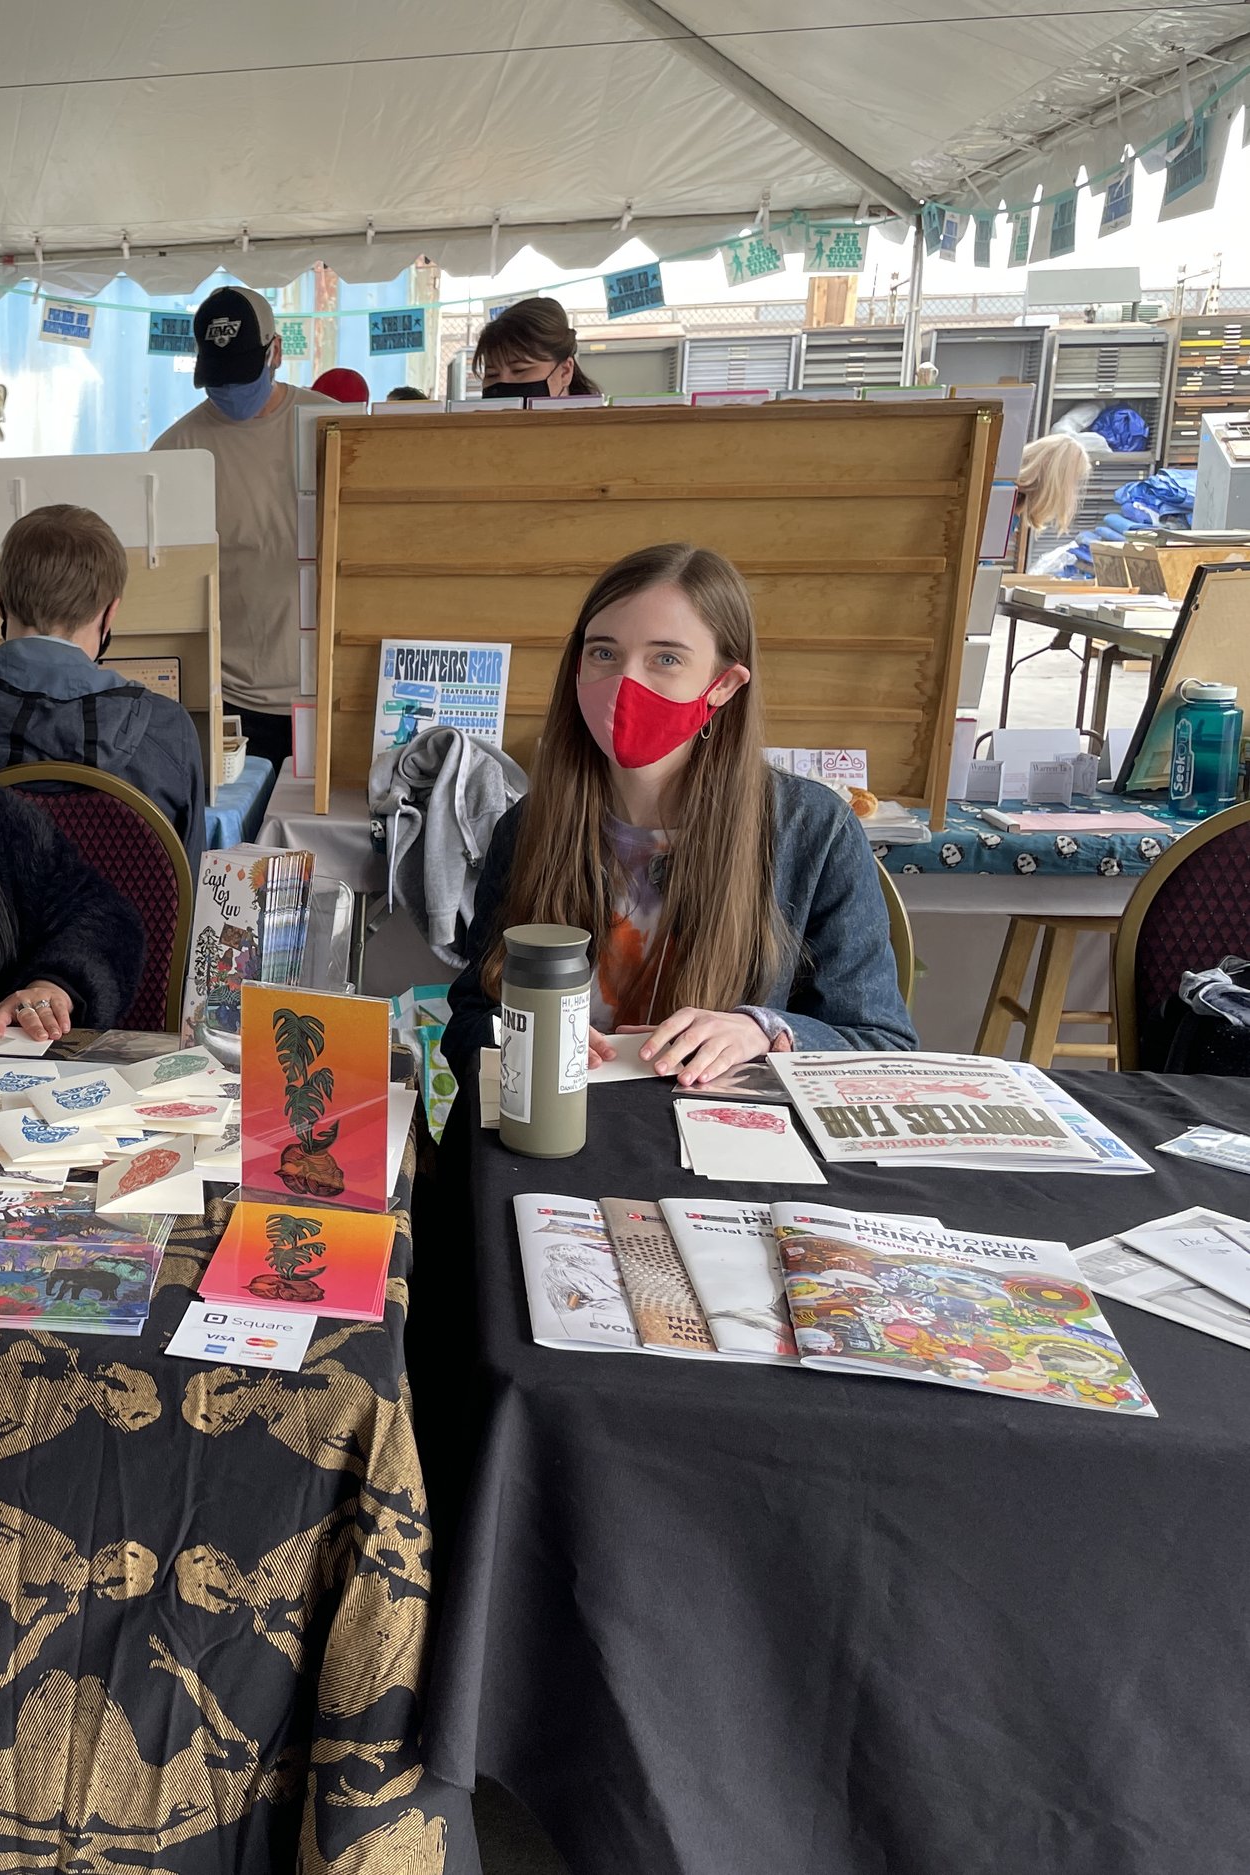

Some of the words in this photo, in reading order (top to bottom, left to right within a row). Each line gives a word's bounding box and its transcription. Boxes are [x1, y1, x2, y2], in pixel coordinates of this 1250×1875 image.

[836, 232, 859, 240] LET
[394, 648, 468, 683] PRINTERS
[438, 716, 498, 728] IMPRESSIONS
[971, 761, 994, 771] Warren
[1032, 763, 1058, 772] Warren
[202, 868, 227, 887] East
[212, 884, 230, 906] Los
[220, 900, 241, 920] Luv
[813, 1104, 900, 1139] FAIR
[893, 1104, 1069, 1138] PRINTERS
[861, 1137, 948, 1149] ANGELES
[959, 1136, 998, 1147] LOS
[1010, 1138, 1052, 1147] 2019
[693, 1223, 742, 1236] Social
[850, 1216, 892, 1230] THE
[900, 1227, 1036, 1252] CALIFORNIA
[853, 1223, 1039, 1261] PRINTMAKER
[856, 1235, 915, 1254] Printing
[936, 1252, 975, 1263] Color
[231, 1317, 294, 1332] Square
[664, 1314, 700, 1327] THE
[206, 1333, 237, 1342] VISA
[671, 1332, 712, 1344] AND
